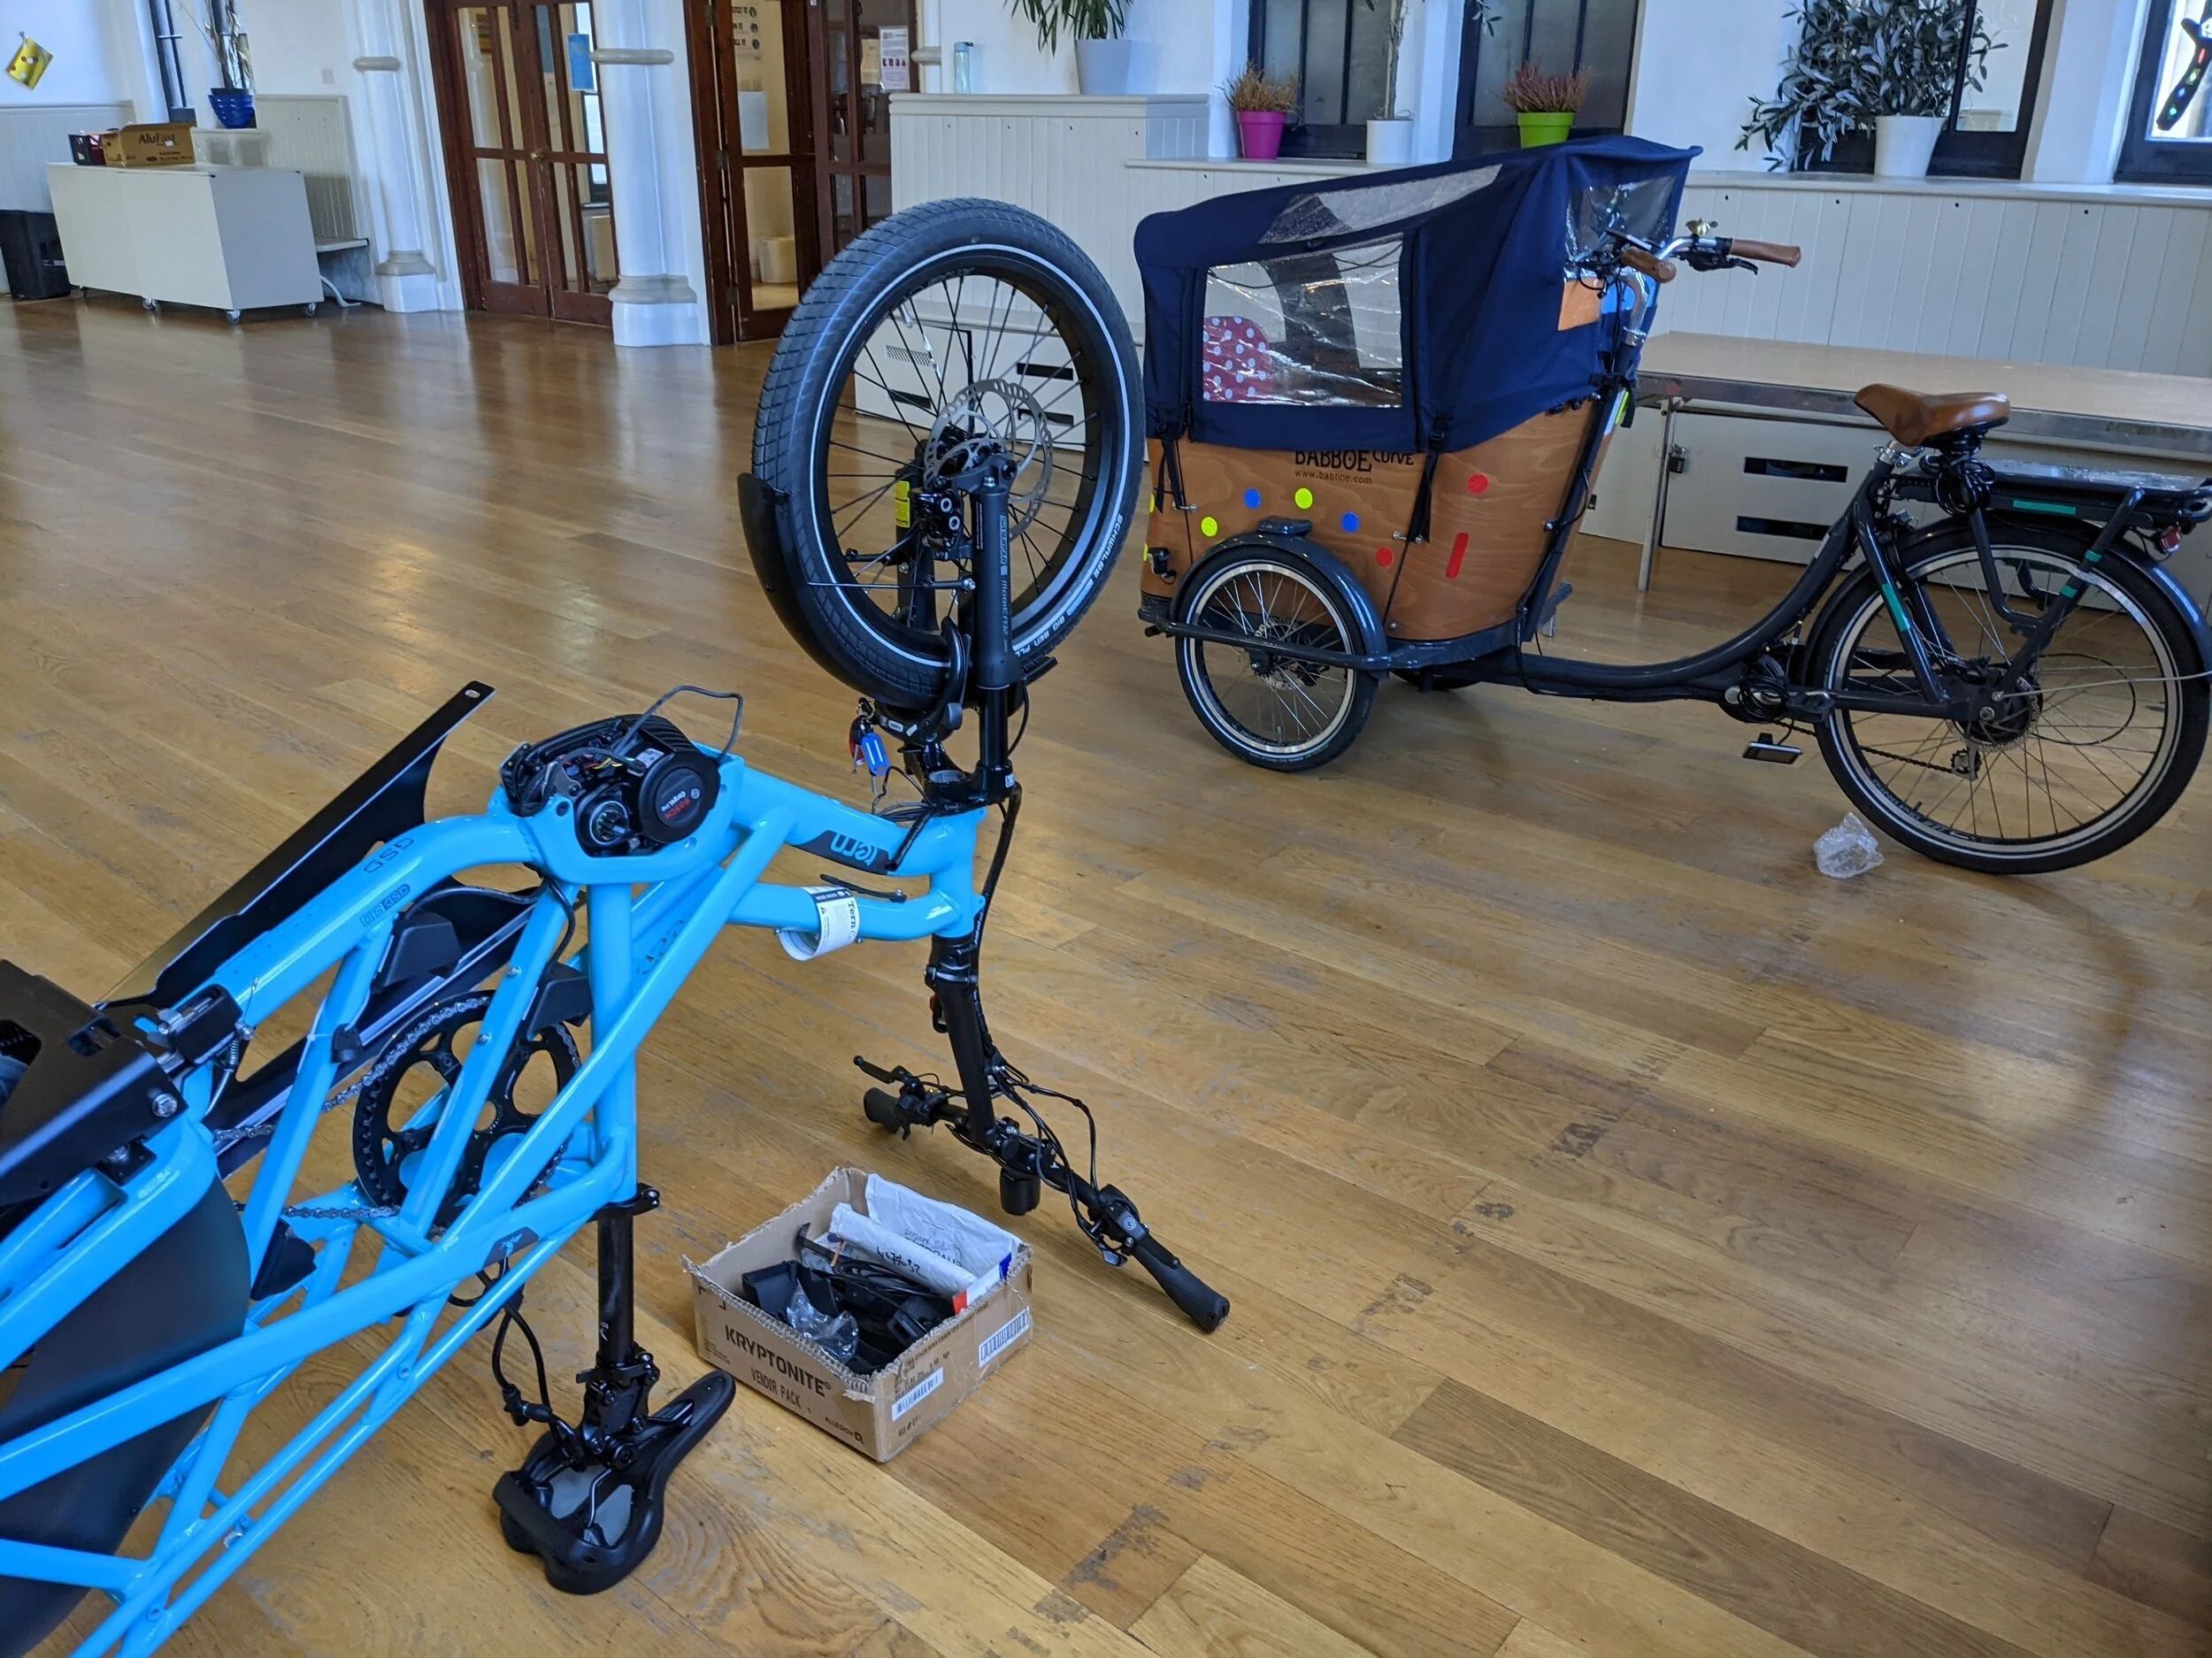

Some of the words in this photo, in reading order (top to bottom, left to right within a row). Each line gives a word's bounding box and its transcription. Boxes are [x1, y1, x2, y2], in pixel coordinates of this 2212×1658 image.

[1294, 449, 1372, 472] BABBOE
[1094, 512, 1124, 580] SCHWALBE
[363, 837, 415, 873] GSD
[750, 1367, 778, 1395] VENDOR
[780, 1383, 801, 1409] PACK
